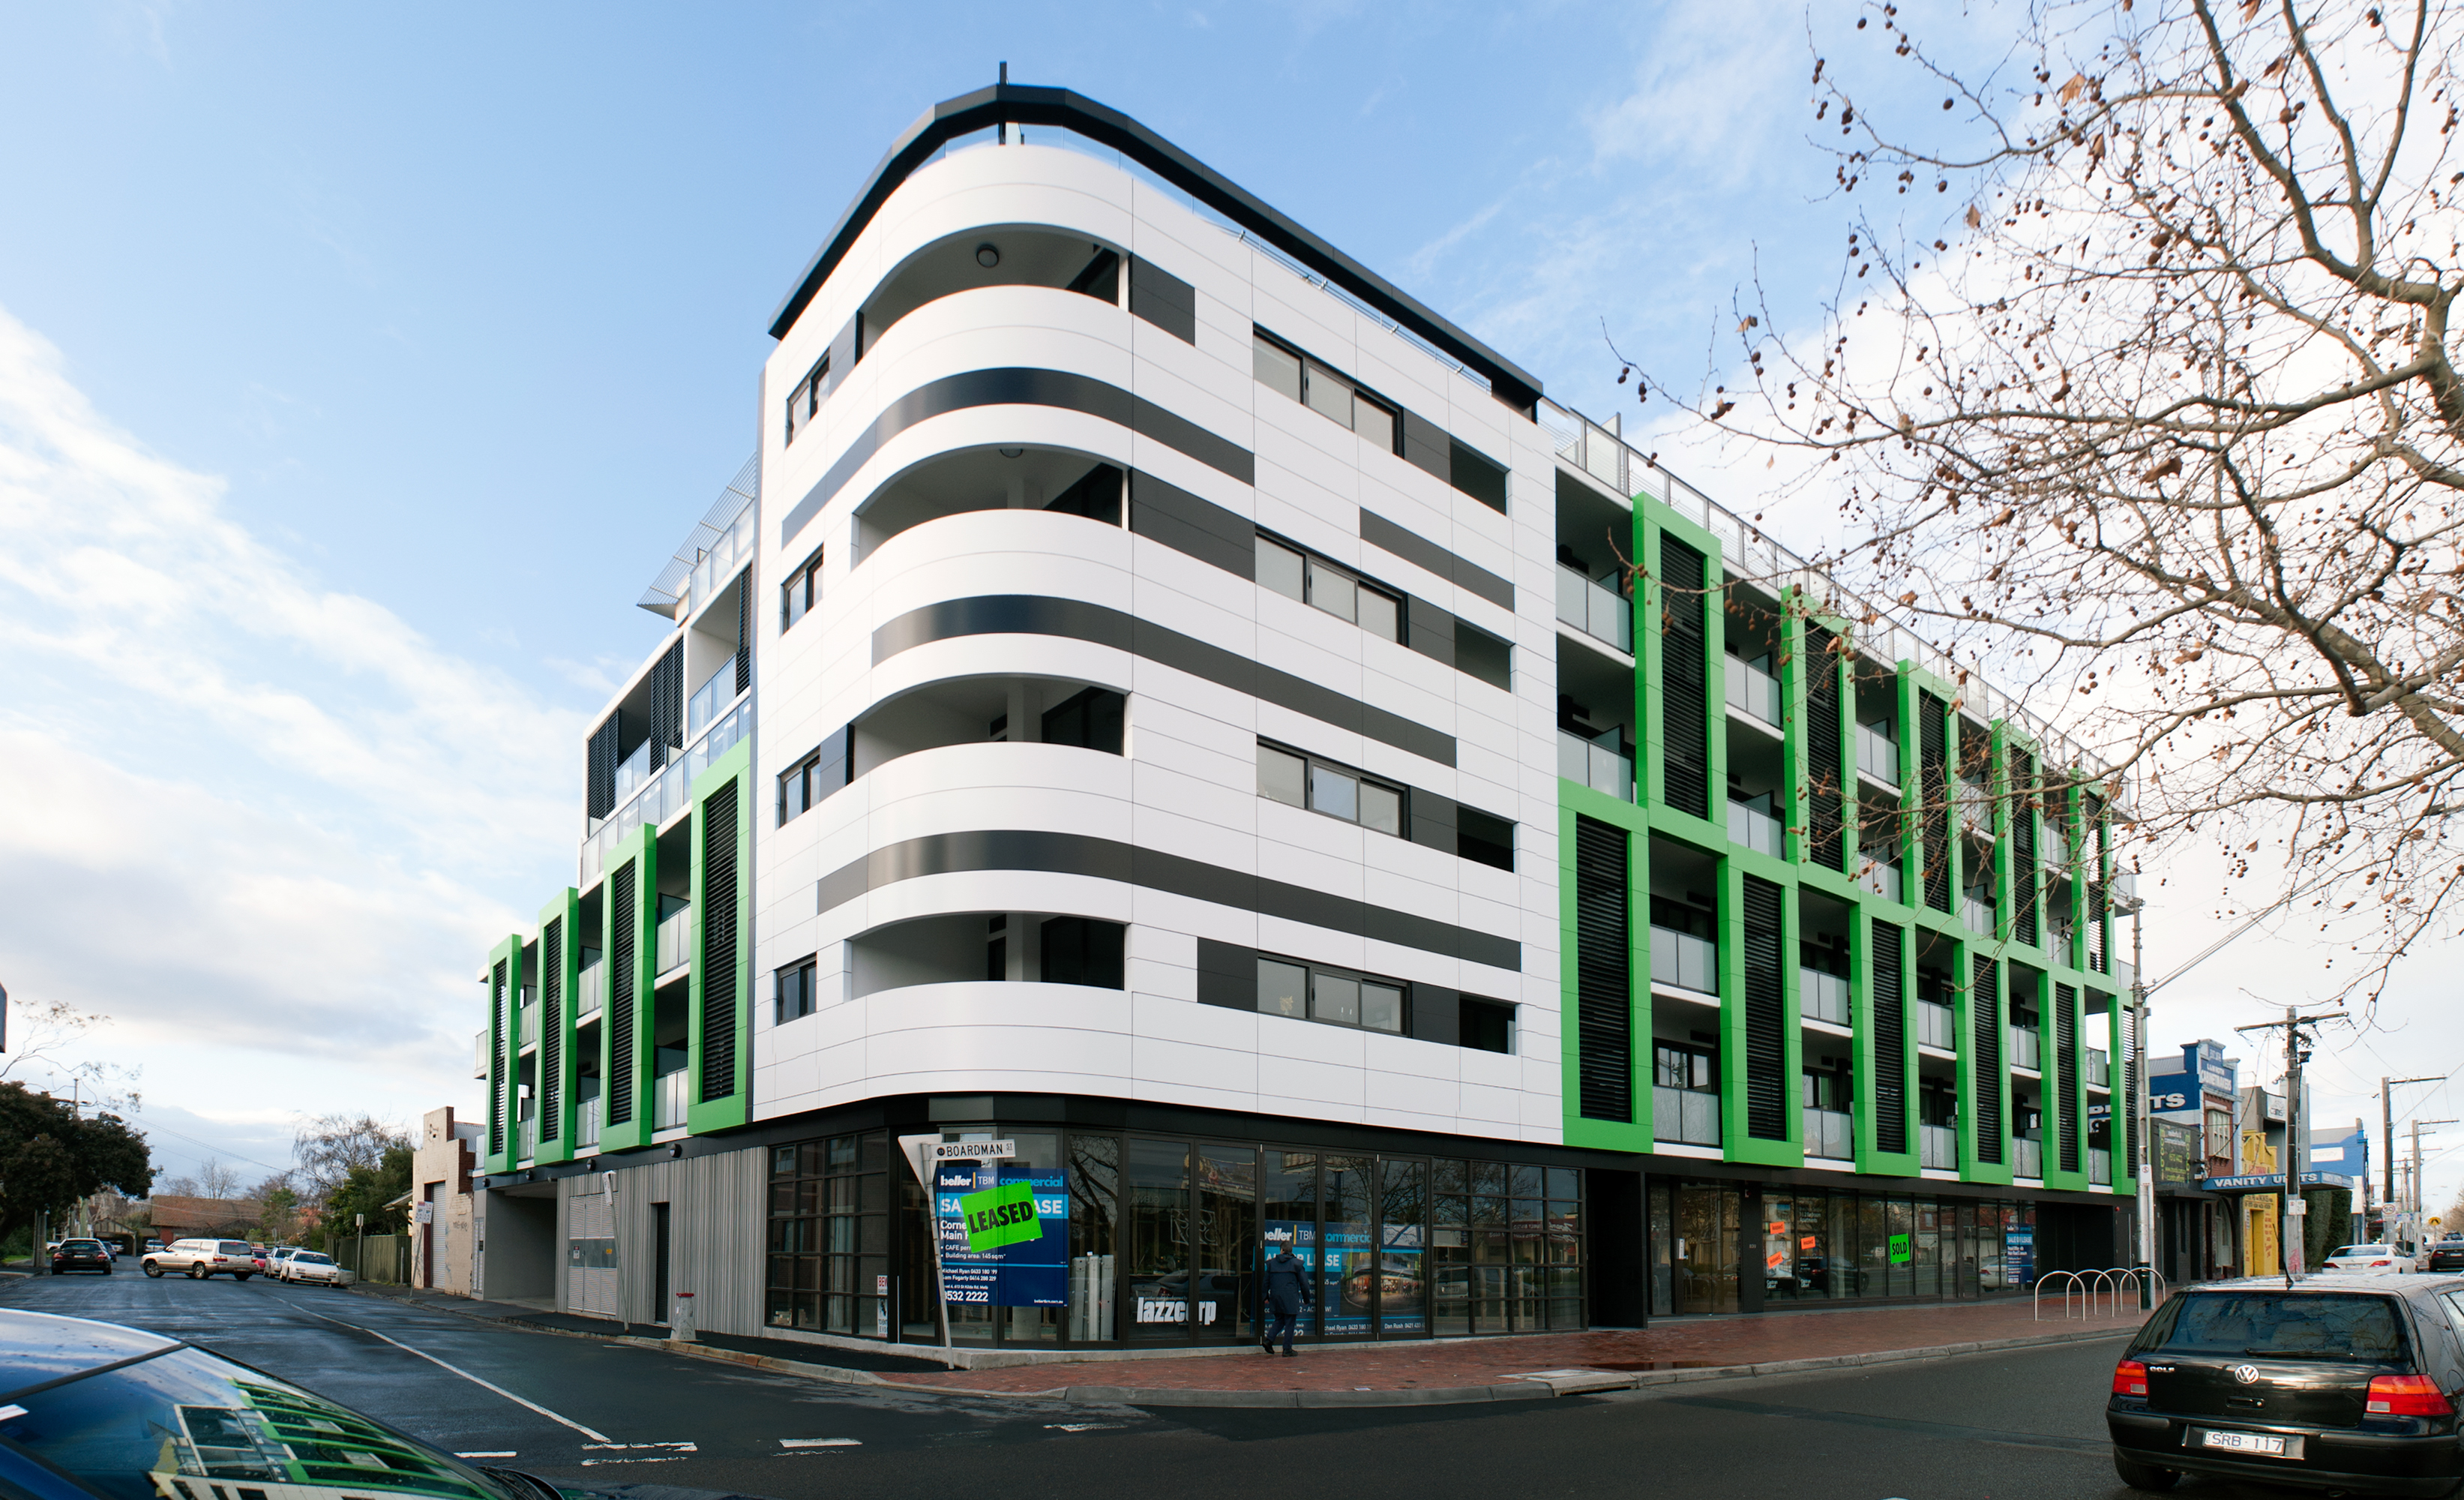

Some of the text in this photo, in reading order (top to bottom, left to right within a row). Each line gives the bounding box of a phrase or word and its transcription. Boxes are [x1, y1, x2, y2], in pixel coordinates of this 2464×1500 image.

[946, 1144, 1003, 1156] BOARDMAN
[940, 1175, 972, 1186] beller
[977, 1176, 995, 1185] TBM
[2214, 1173, 2318, 1187] VANITY UTS
[1034, 1199, 1063, 1214] ASE
[967, 1201, 1033, 1234] LEASED
[940, 1220, 967, 1230] Corne
[940, 1230, 963, 1240] Main
[1299, 1230, 1316, 1240] TBM
[1892, 1241, 1908, 1256] SOLD
[966, 1292, 988, 1302] 2222
